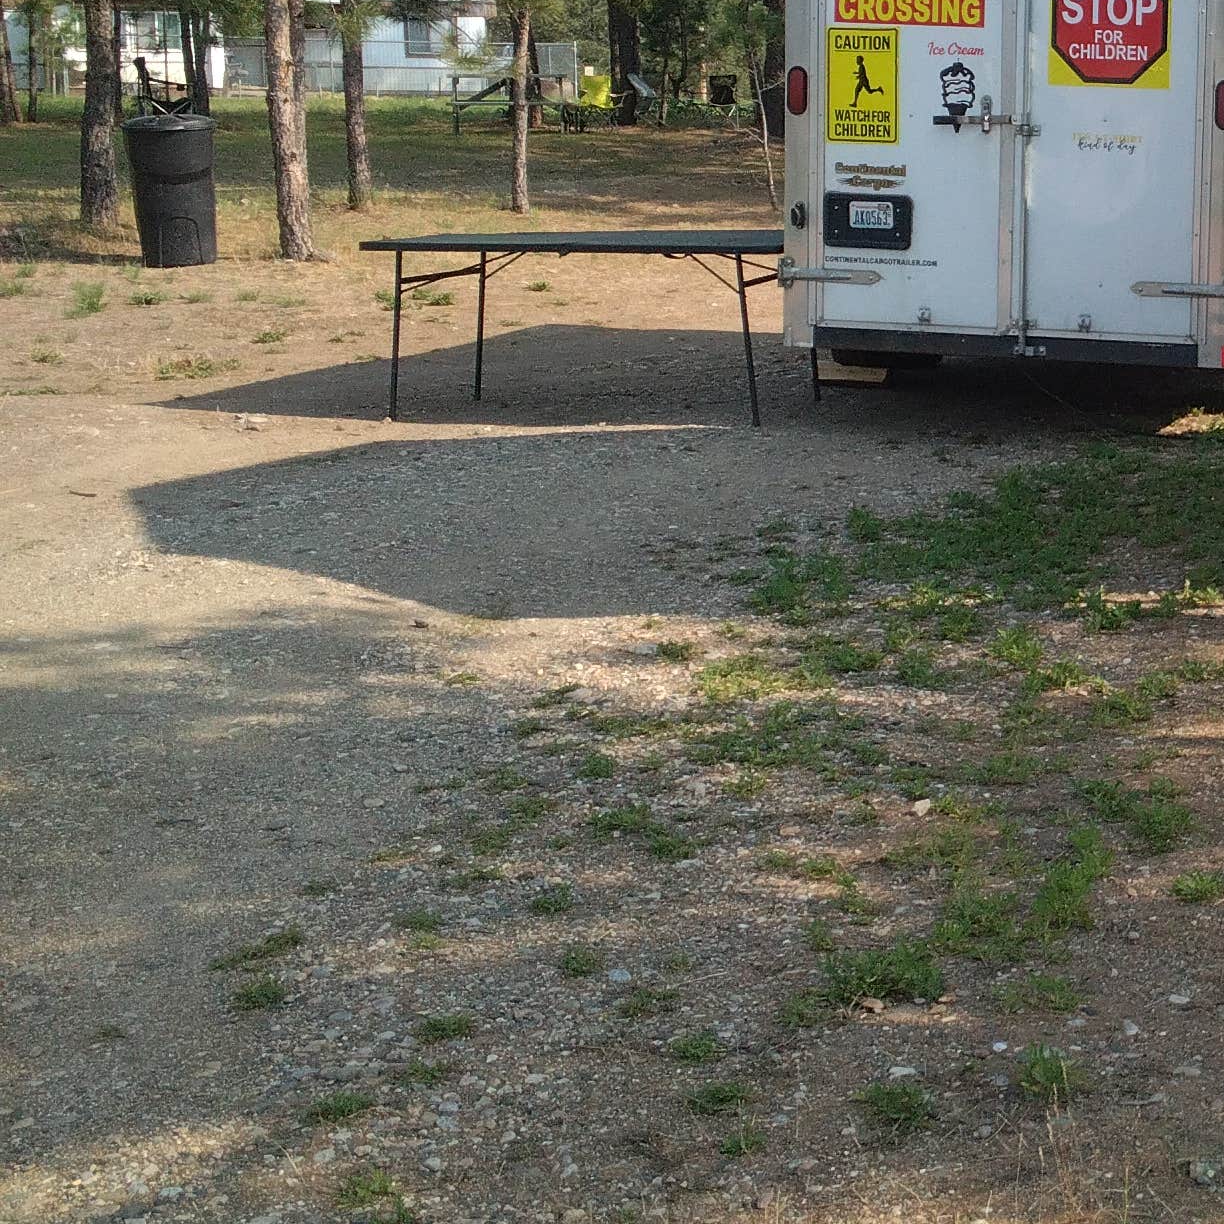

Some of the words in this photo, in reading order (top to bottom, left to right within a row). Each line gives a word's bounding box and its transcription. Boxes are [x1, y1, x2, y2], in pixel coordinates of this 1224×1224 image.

[834, 34, 891, 51] CAUTION
[1094, 29, 1124, 44] FOR
[927, 41, 944, 56] Ice
[947, 42, 985, 56] Cream
[1068, 43, 1148, 61] CHILDREN
[834, 109, 871, 122] WATCH
[871, 110, 891, 123] FOR
[834, 123, 891, 138] CHILDREN
[1078, 137, 1102, 151] kind
[1104, 140, 1114, 152] of
[1117, 137, 1137, 155] day
